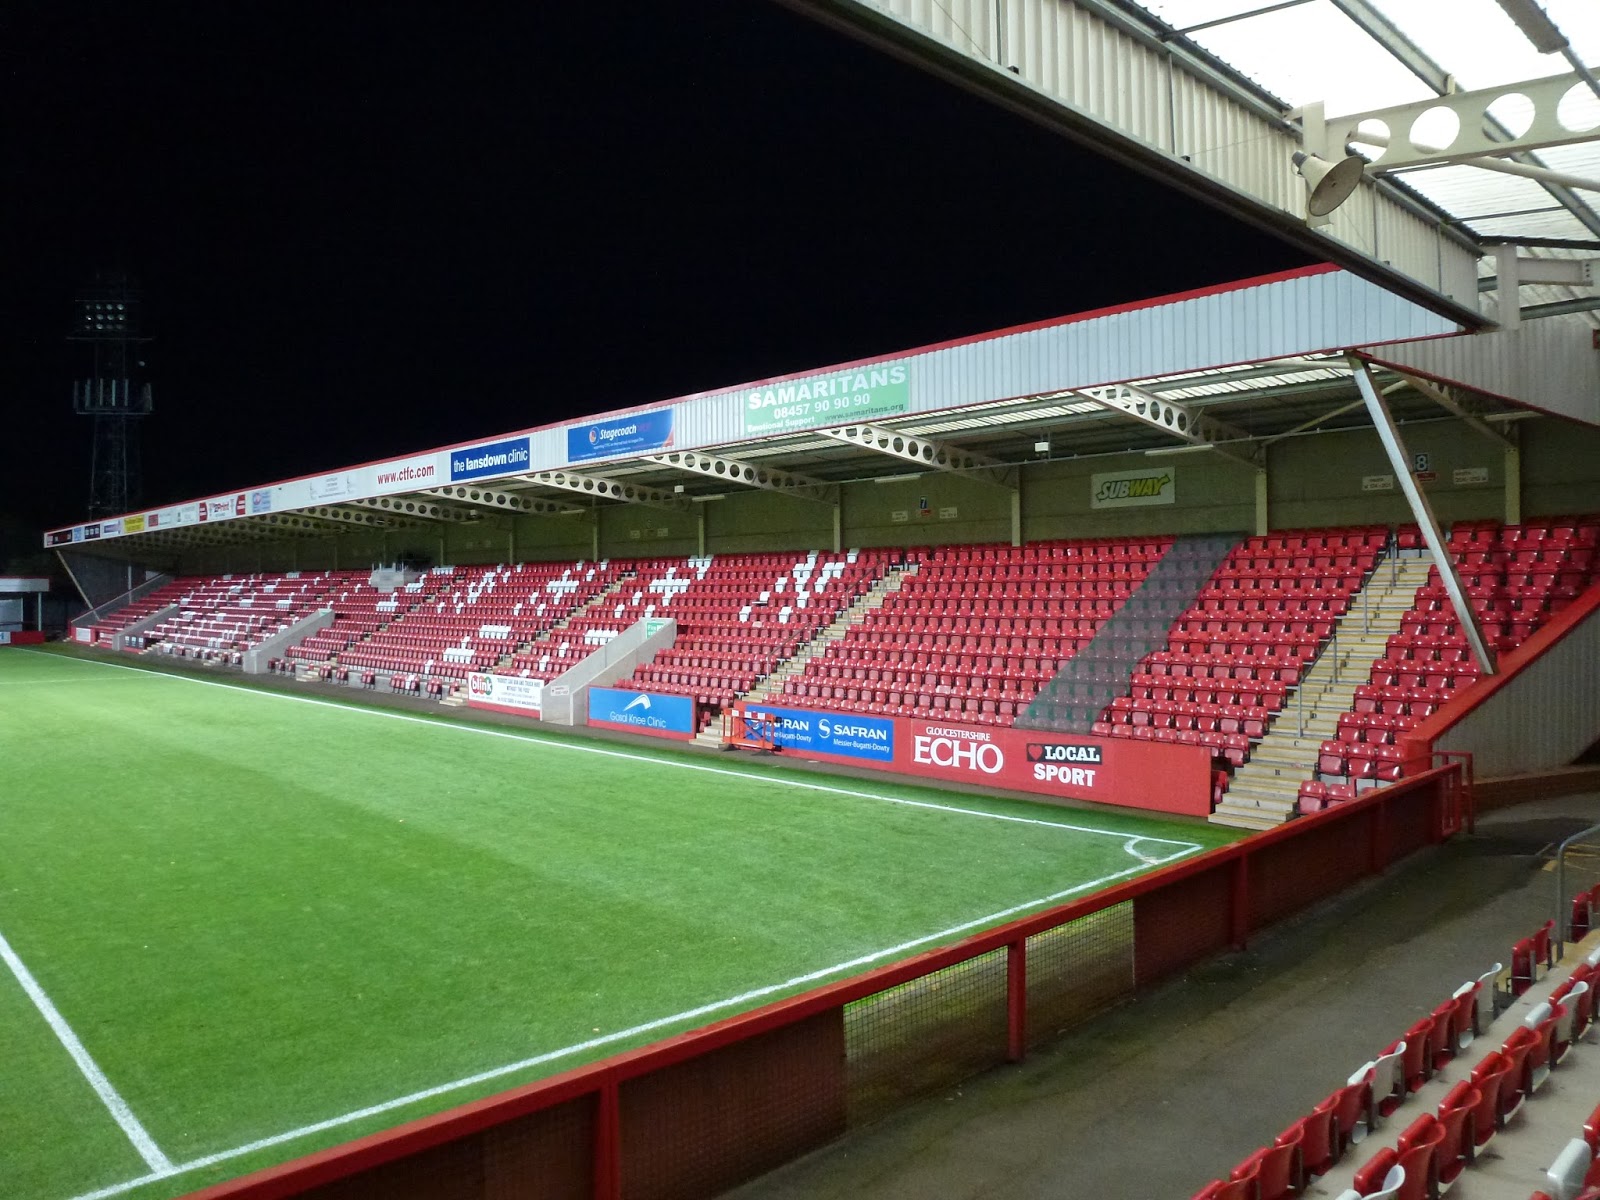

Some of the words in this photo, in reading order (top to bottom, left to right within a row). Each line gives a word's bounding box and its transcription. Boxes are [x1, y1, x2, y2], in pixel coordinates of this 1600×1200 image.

[749, 366, 906, 409] SAMARITANS
[774, 403, 810, 419] 08457
[815, 399, 830, 413] 90
[834, 397, 849, 410] 90
[853, 393, 871, 405] 90
[824, 403, 904, 422] www.samaritans.org
[599, 424, 637, 441] Stagecoach
[747, 418, 788, 433] Emotional
[785, 416, 815, 429] Support
[454, 456, 465, 473] the
[466, 452, 507, 470] lansdown
[508, 448, 528, 463] clinic
[1416, 454, 1428, 471] 8
[377, 463, 435, 485] www.ctfc.com
[1096, 474, 1171, 501] SUBWAY
[472, 676, 492, 692] blink
[629, 714, 646, 725] Knee
[647, 716, 667, 728] Clinic
[833, 724, 887, 740] SAFRAN
[926, 726, 991, 742] GLOUCESTERSHIRE
[913, 735, 1004, 774] ECHO
[1044, 745, 1100, 762] LOCAL
[1033, 763, 1096, 787] SPORT
